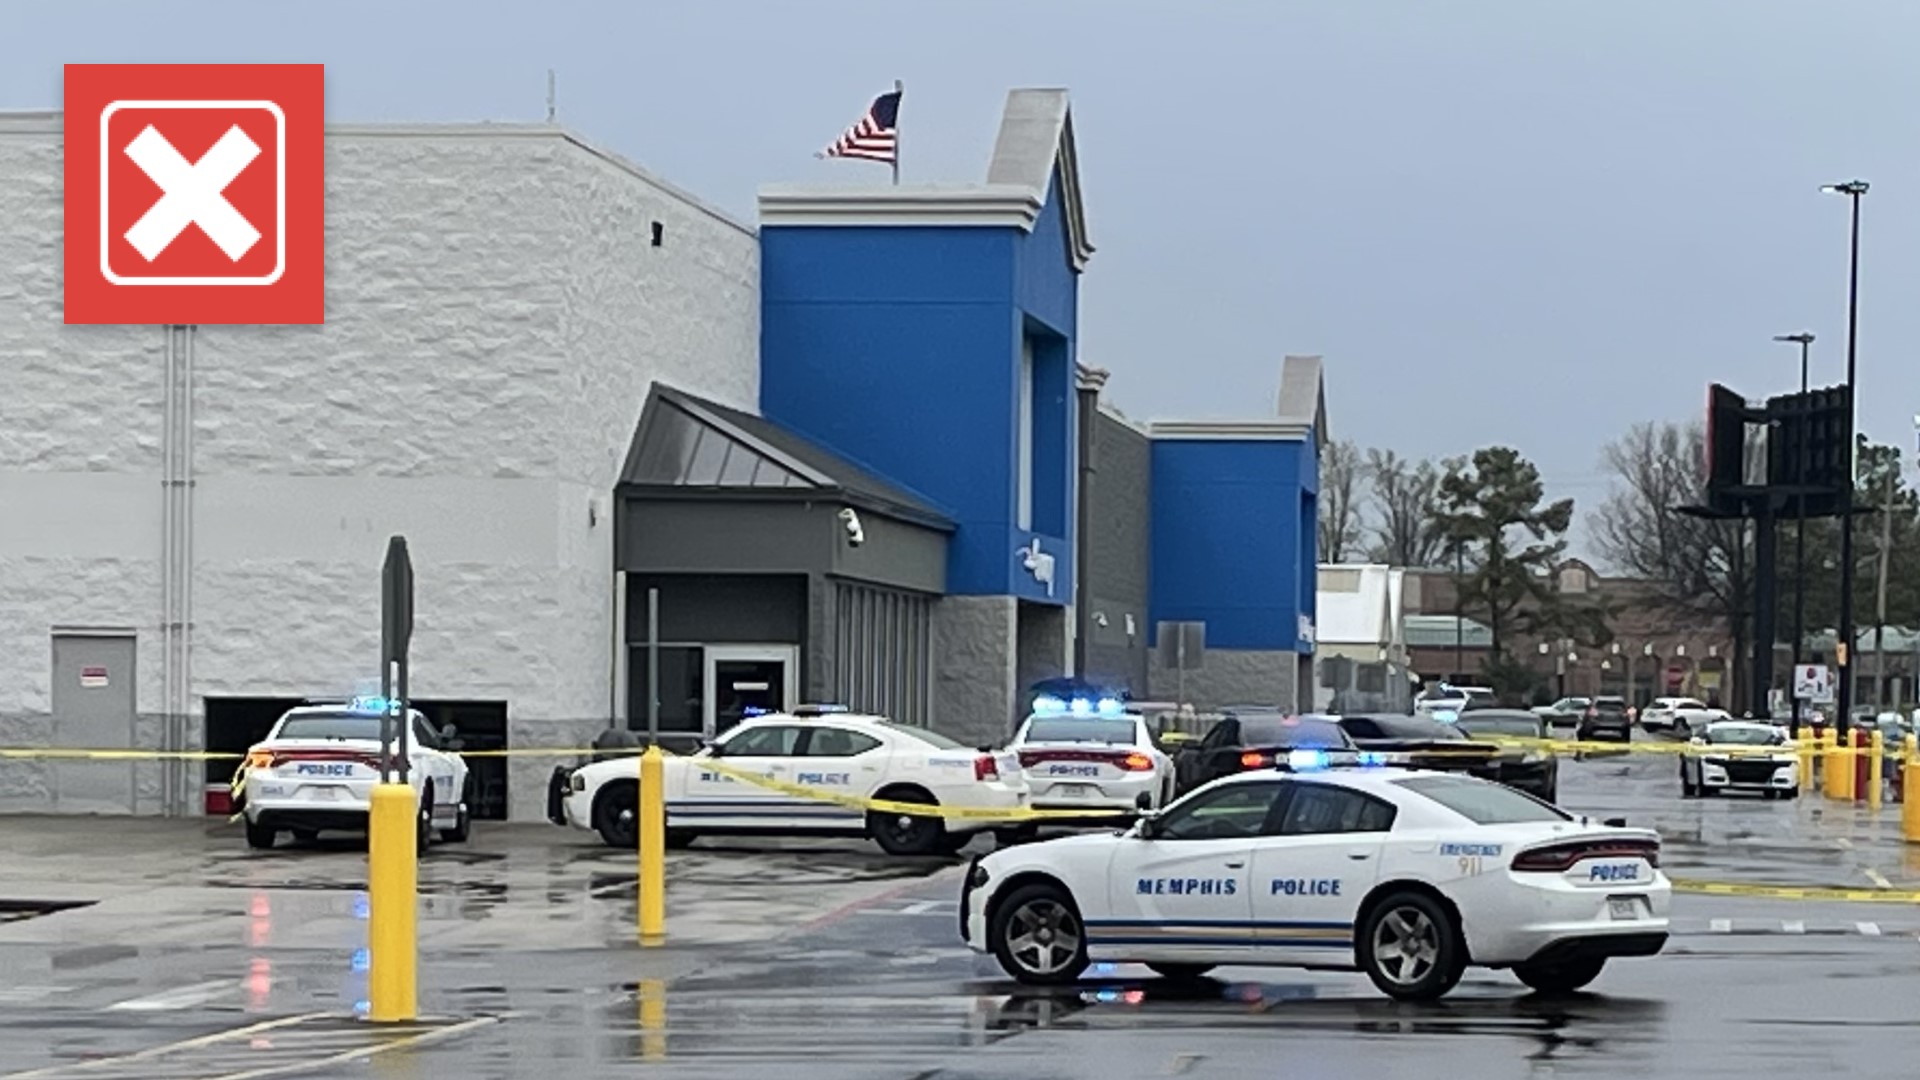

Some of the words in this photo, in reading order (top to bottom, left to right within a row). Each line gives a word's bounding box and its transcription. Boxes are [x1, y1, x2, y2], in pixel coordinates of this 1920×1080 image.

[797, 773, 850, 785] POLICE
[1458, 857, 1482, 877] 911
[1589, 864, 1639, 881] POLICE
[1136, 878, 1237, 896] MEMPHIS
[1271, 878, 1342, 896] POLICE
